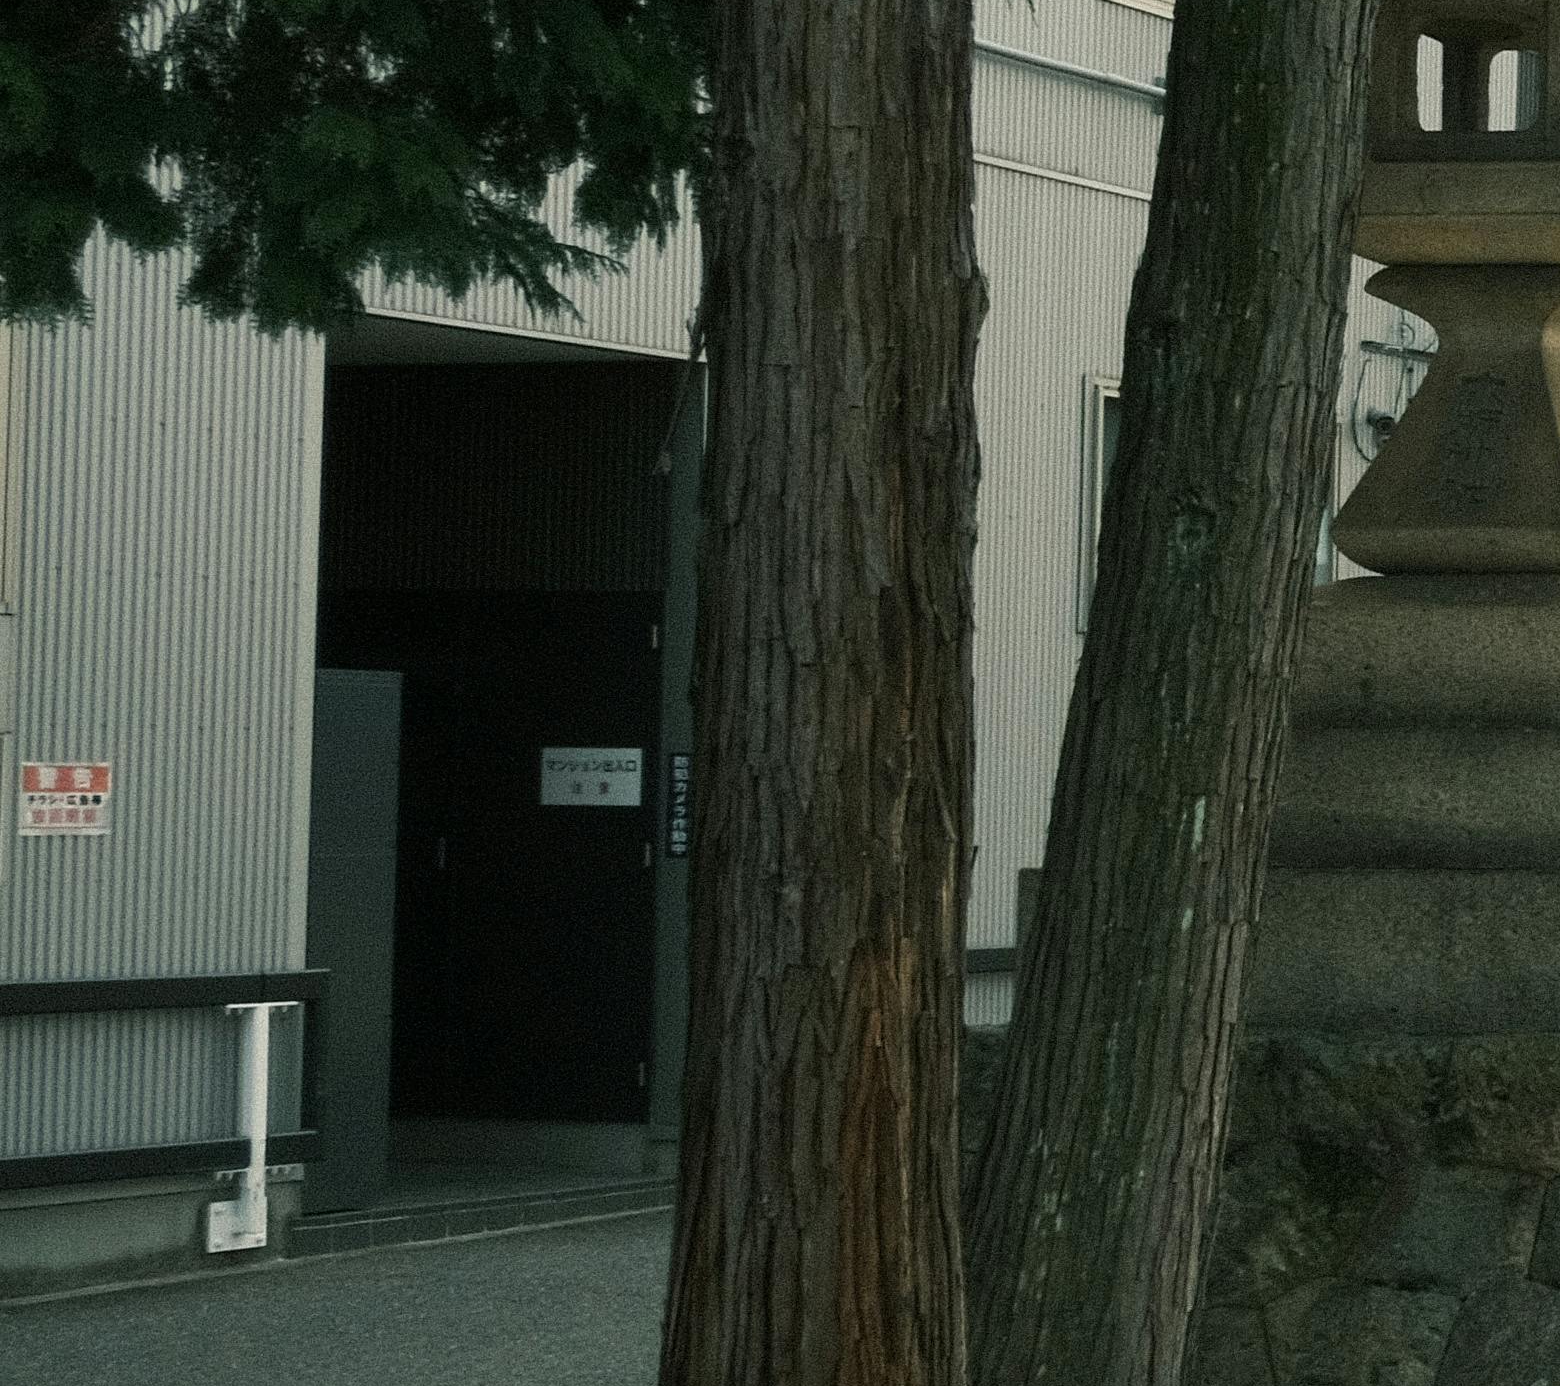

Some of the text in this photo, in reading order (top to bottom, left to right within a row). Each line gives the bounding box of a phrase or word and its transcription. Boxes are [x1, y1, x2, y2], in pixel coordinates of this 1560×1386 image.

[546, 760, 638, 773] マンション出入口
[38, 767, 93, 791] 警告
